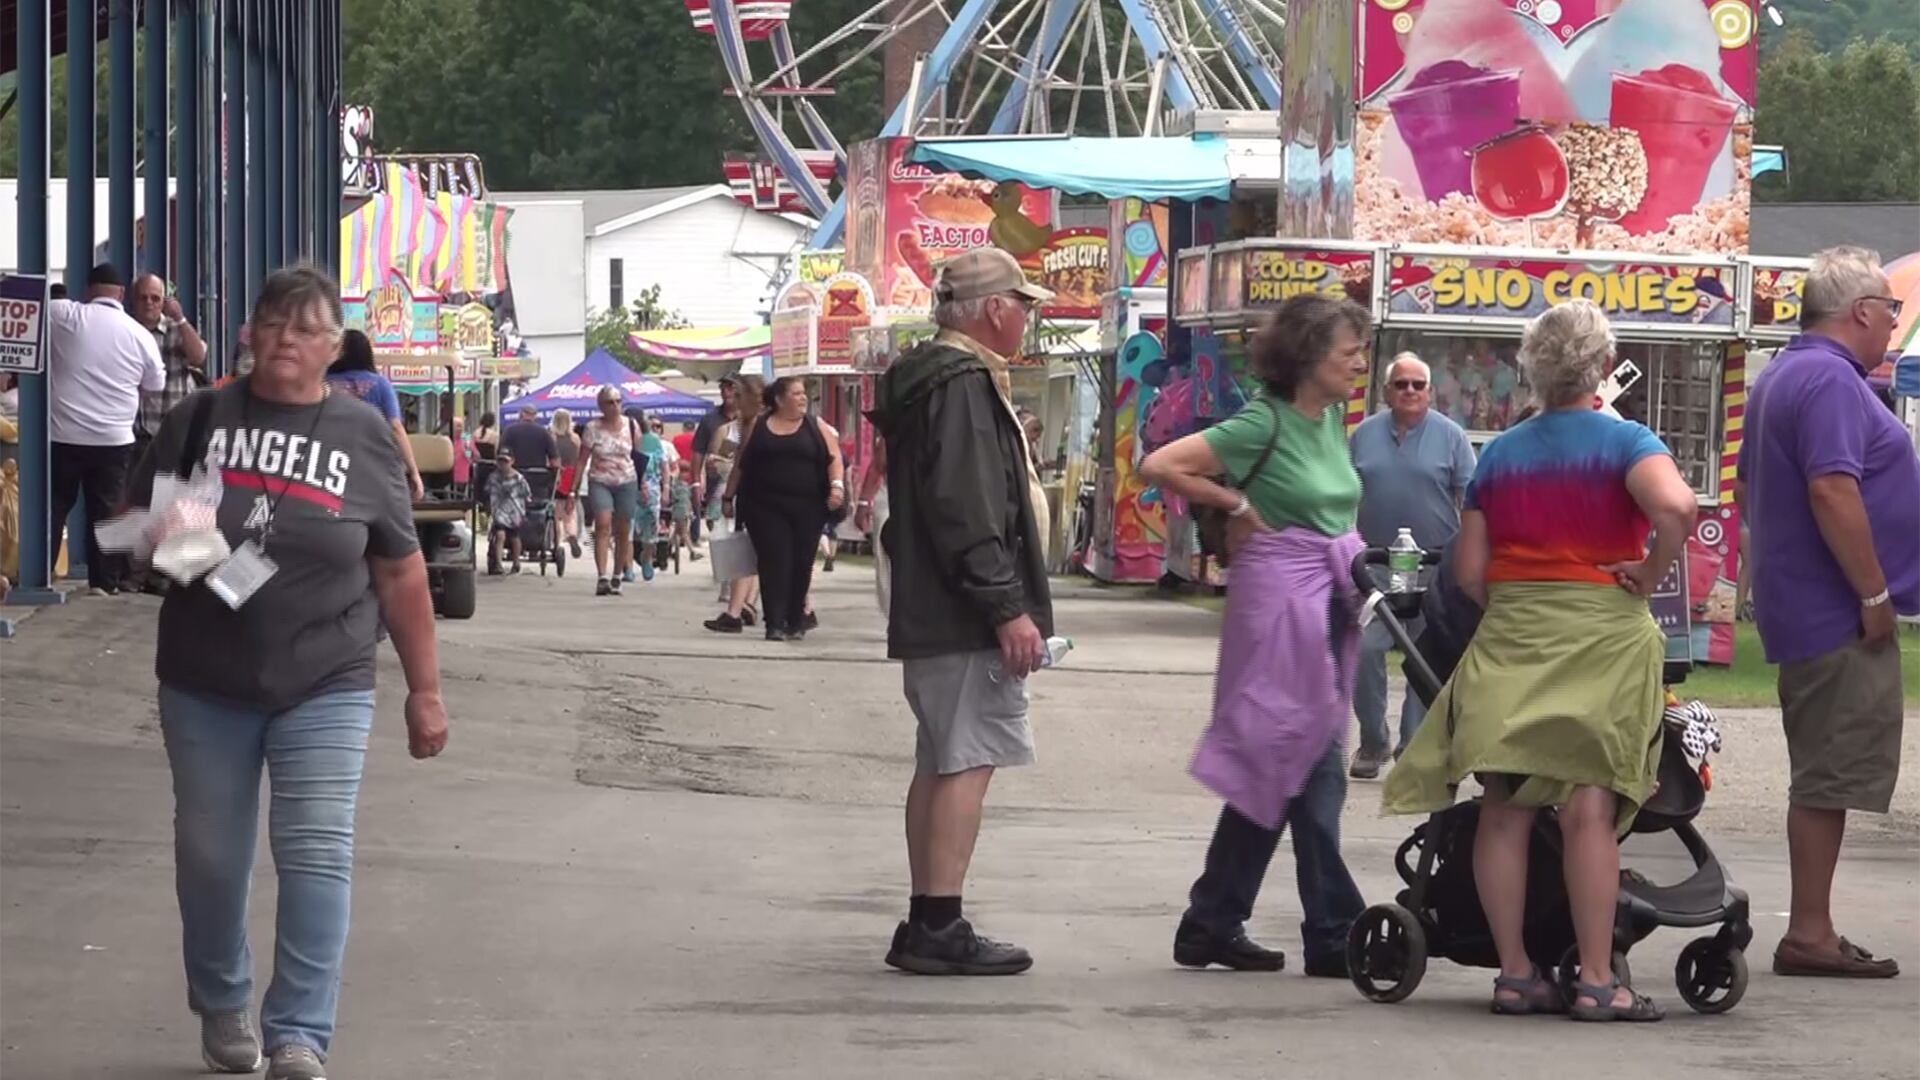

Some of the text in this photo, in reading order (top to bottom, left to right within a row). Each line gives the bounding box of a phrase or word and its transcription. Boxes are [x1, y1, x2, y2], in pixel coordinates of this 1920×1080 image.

[1044, 245, 1077, 274] FRESH
[1078, 244, 1099, 267] CUT
[1259, 260, 1327, 281] COLD
[1250, 281, 1348, 301] DRINKS
[1431, 266, 1699, 314] SNO CONES
[0, 301, 37, 320] TOP
[2, 321, 28, 338] UP
[204, 428, 350, 496] ANGELS
